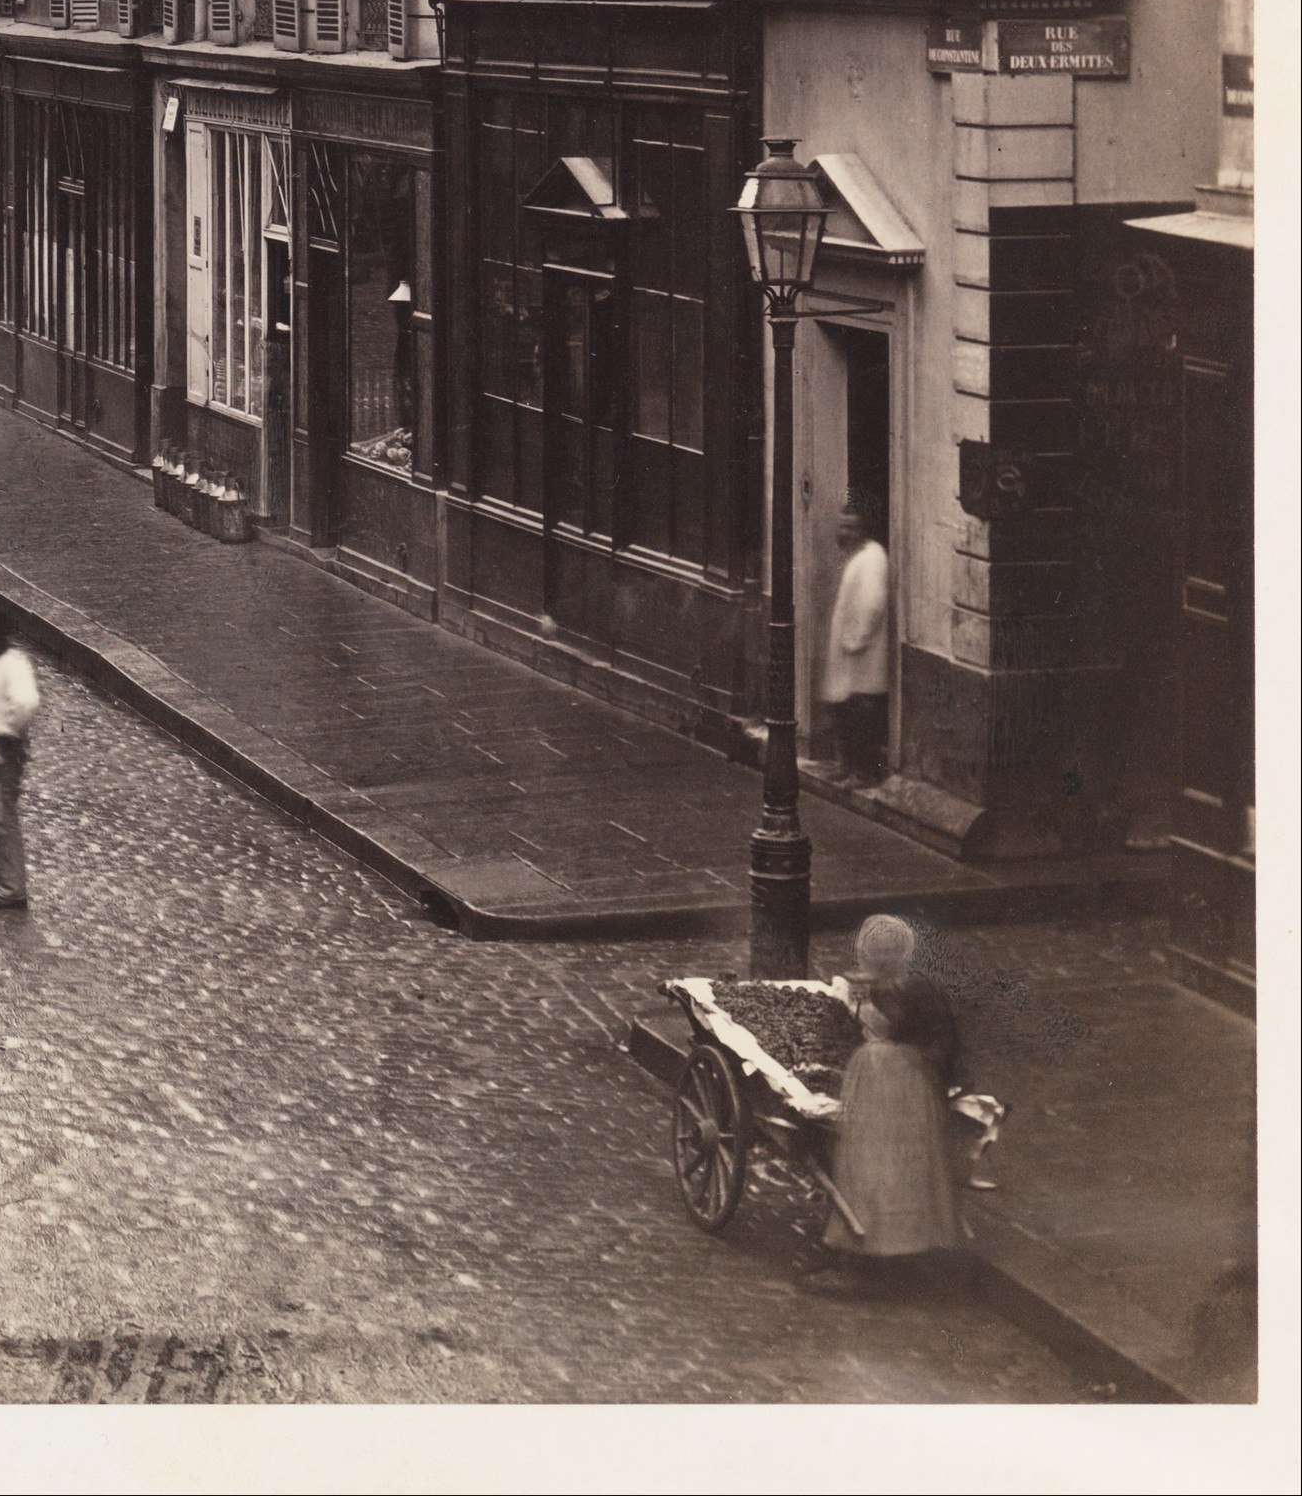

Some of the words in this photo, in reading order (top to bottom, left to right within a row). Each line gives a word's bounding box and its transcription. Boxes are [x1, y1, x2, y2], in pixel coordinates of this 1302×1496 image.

[945, 28, 962, 43] RUE
[1044, 26, 1079, 40] RUE
[1051, 41, 1074, 53] DES
